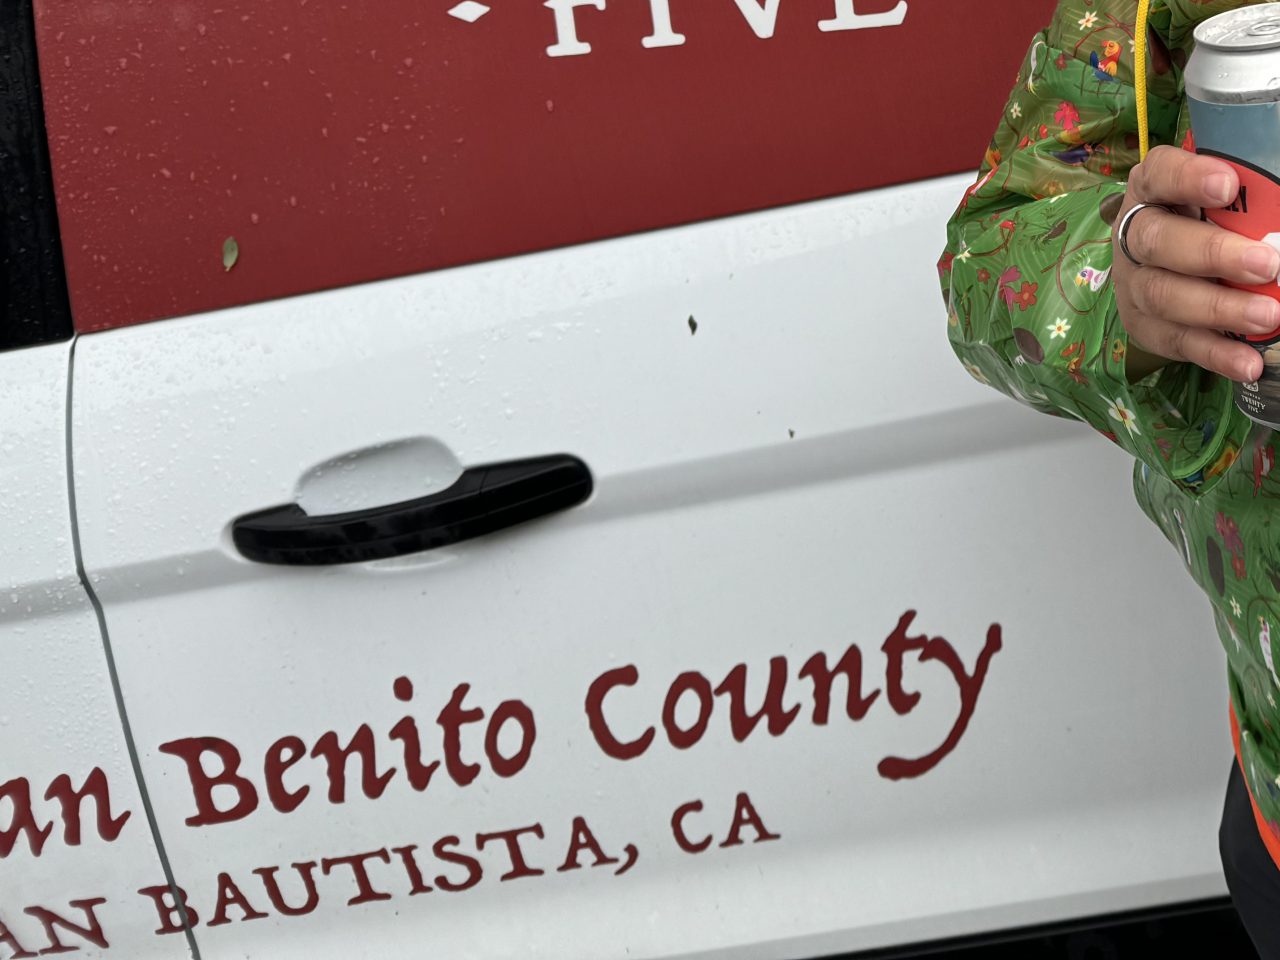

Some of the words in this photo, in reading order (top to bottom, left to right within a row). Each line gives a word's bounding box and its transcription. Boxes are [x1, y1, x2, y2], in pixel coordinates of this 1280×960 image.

[158, 677, 537, 827] Benito
[584, 610, 1002, 779] County
[137, 818, 642, 935] BAUTISTA,
[669, 790, 782, 854] CA
